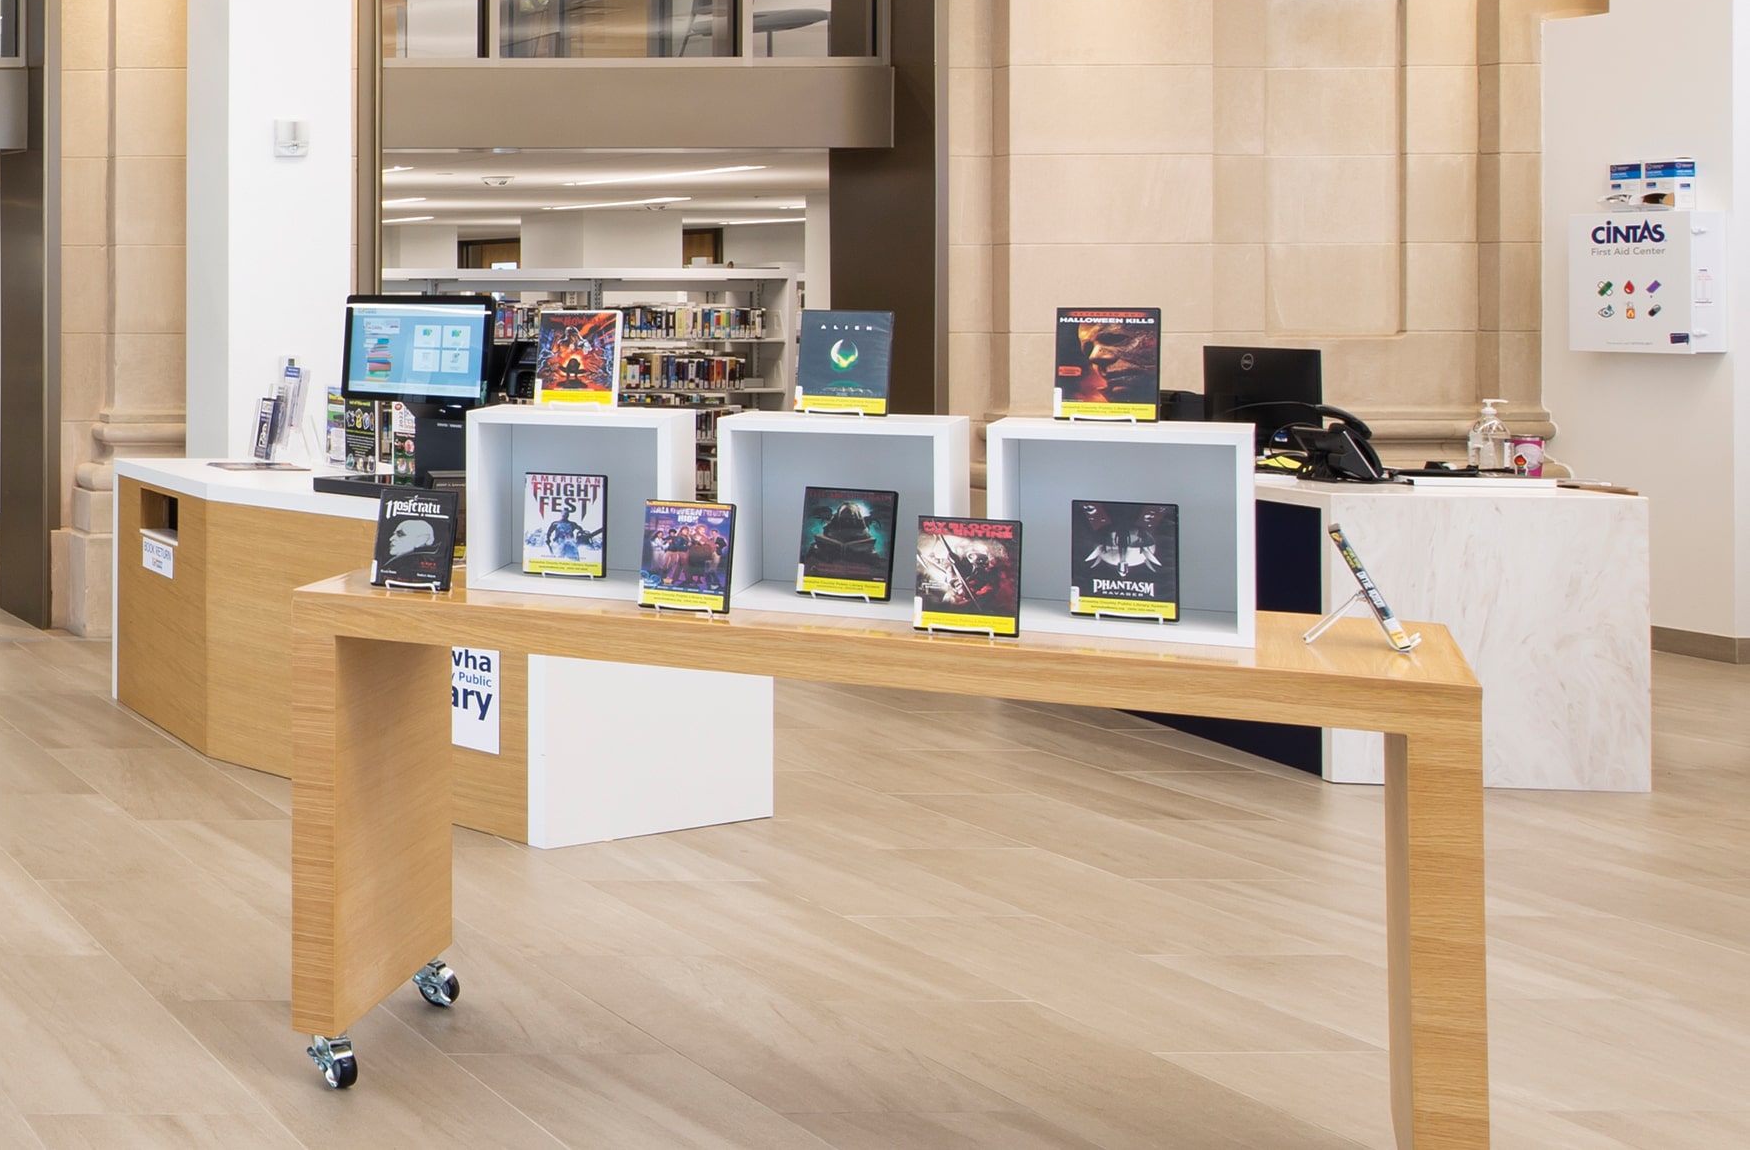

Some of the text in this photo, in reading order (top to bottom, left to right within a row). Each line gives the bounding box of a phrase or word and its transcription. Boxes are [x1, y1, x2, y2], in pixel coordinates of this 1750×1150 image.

[1633, 247, 1666, 255] Center
[531, 475, 601, 484] AMERICAN
[531, 482, 600, 504] FRIGHT
[539, 496, 591, 522] FEST
[949, 523, 1013, 531] BLOODY
[144, 541, 171, 560] BOOK RETURN
[1093, 579, 1154, 597] PHANTASM
[459, 672, 492, 687] Public
